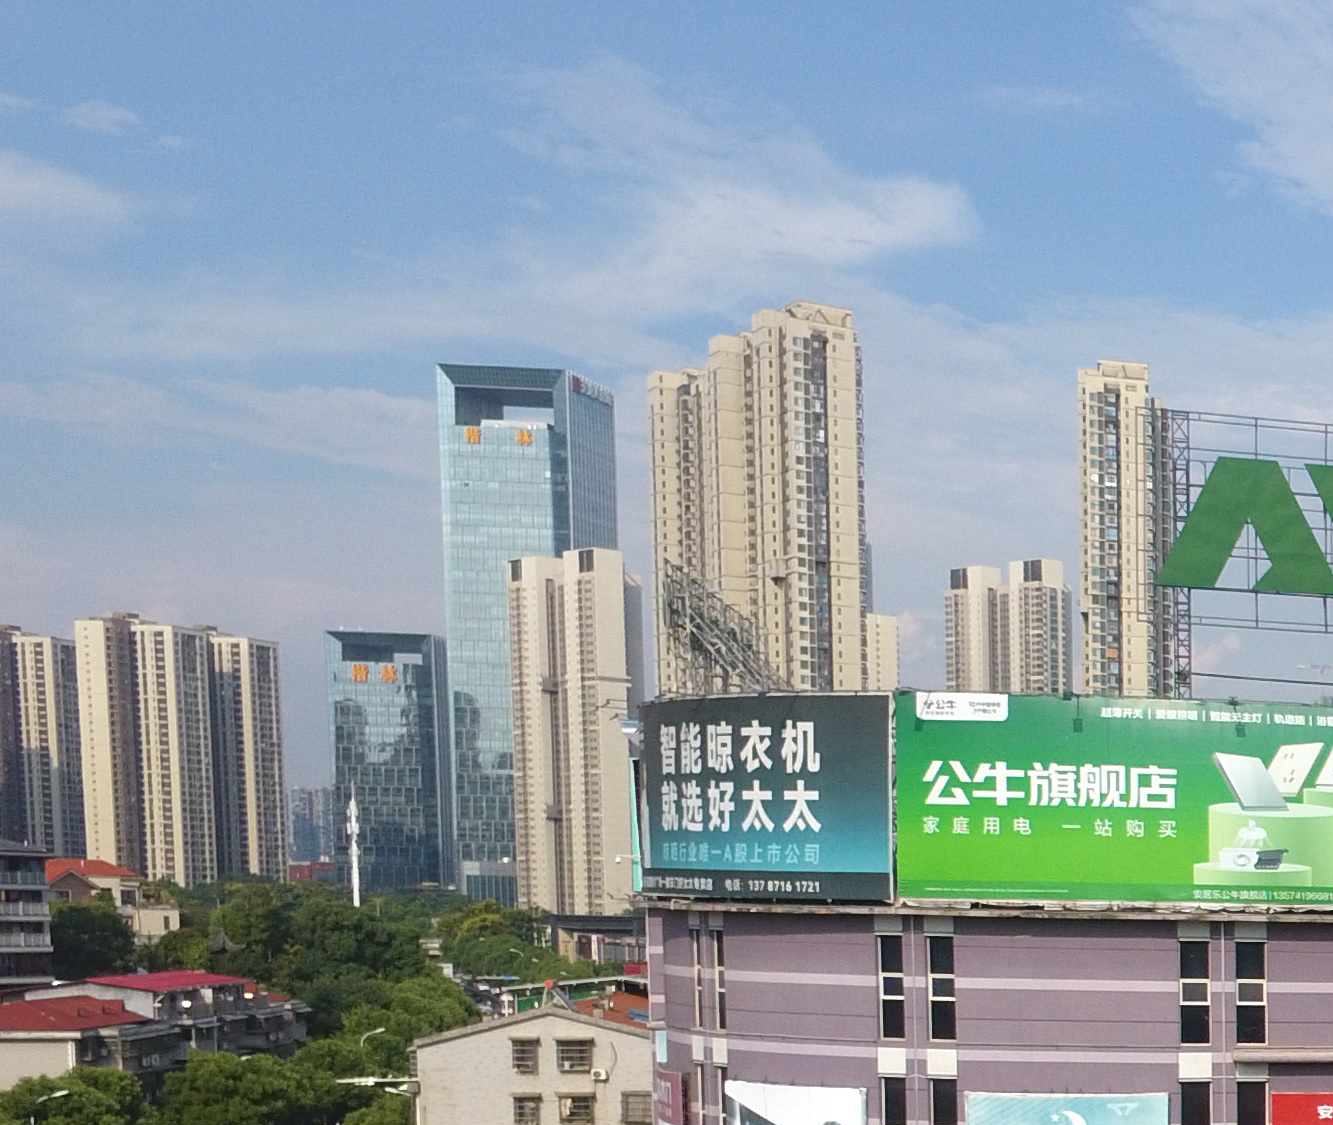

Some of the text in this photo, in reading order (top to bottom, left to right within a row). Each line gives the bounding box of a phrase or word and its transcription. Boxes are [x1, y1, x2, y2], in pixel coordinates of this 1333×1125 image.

[660, 719, 820, 775] 智能晾衣机
[661, 780, 821, 832] 就选好太太
[922, 760, 1177, 809] 公牛旗舰店
[923, 816, 1177, 838] 家庭用电 一站购买
[795, 881, 820, 893] 1721
